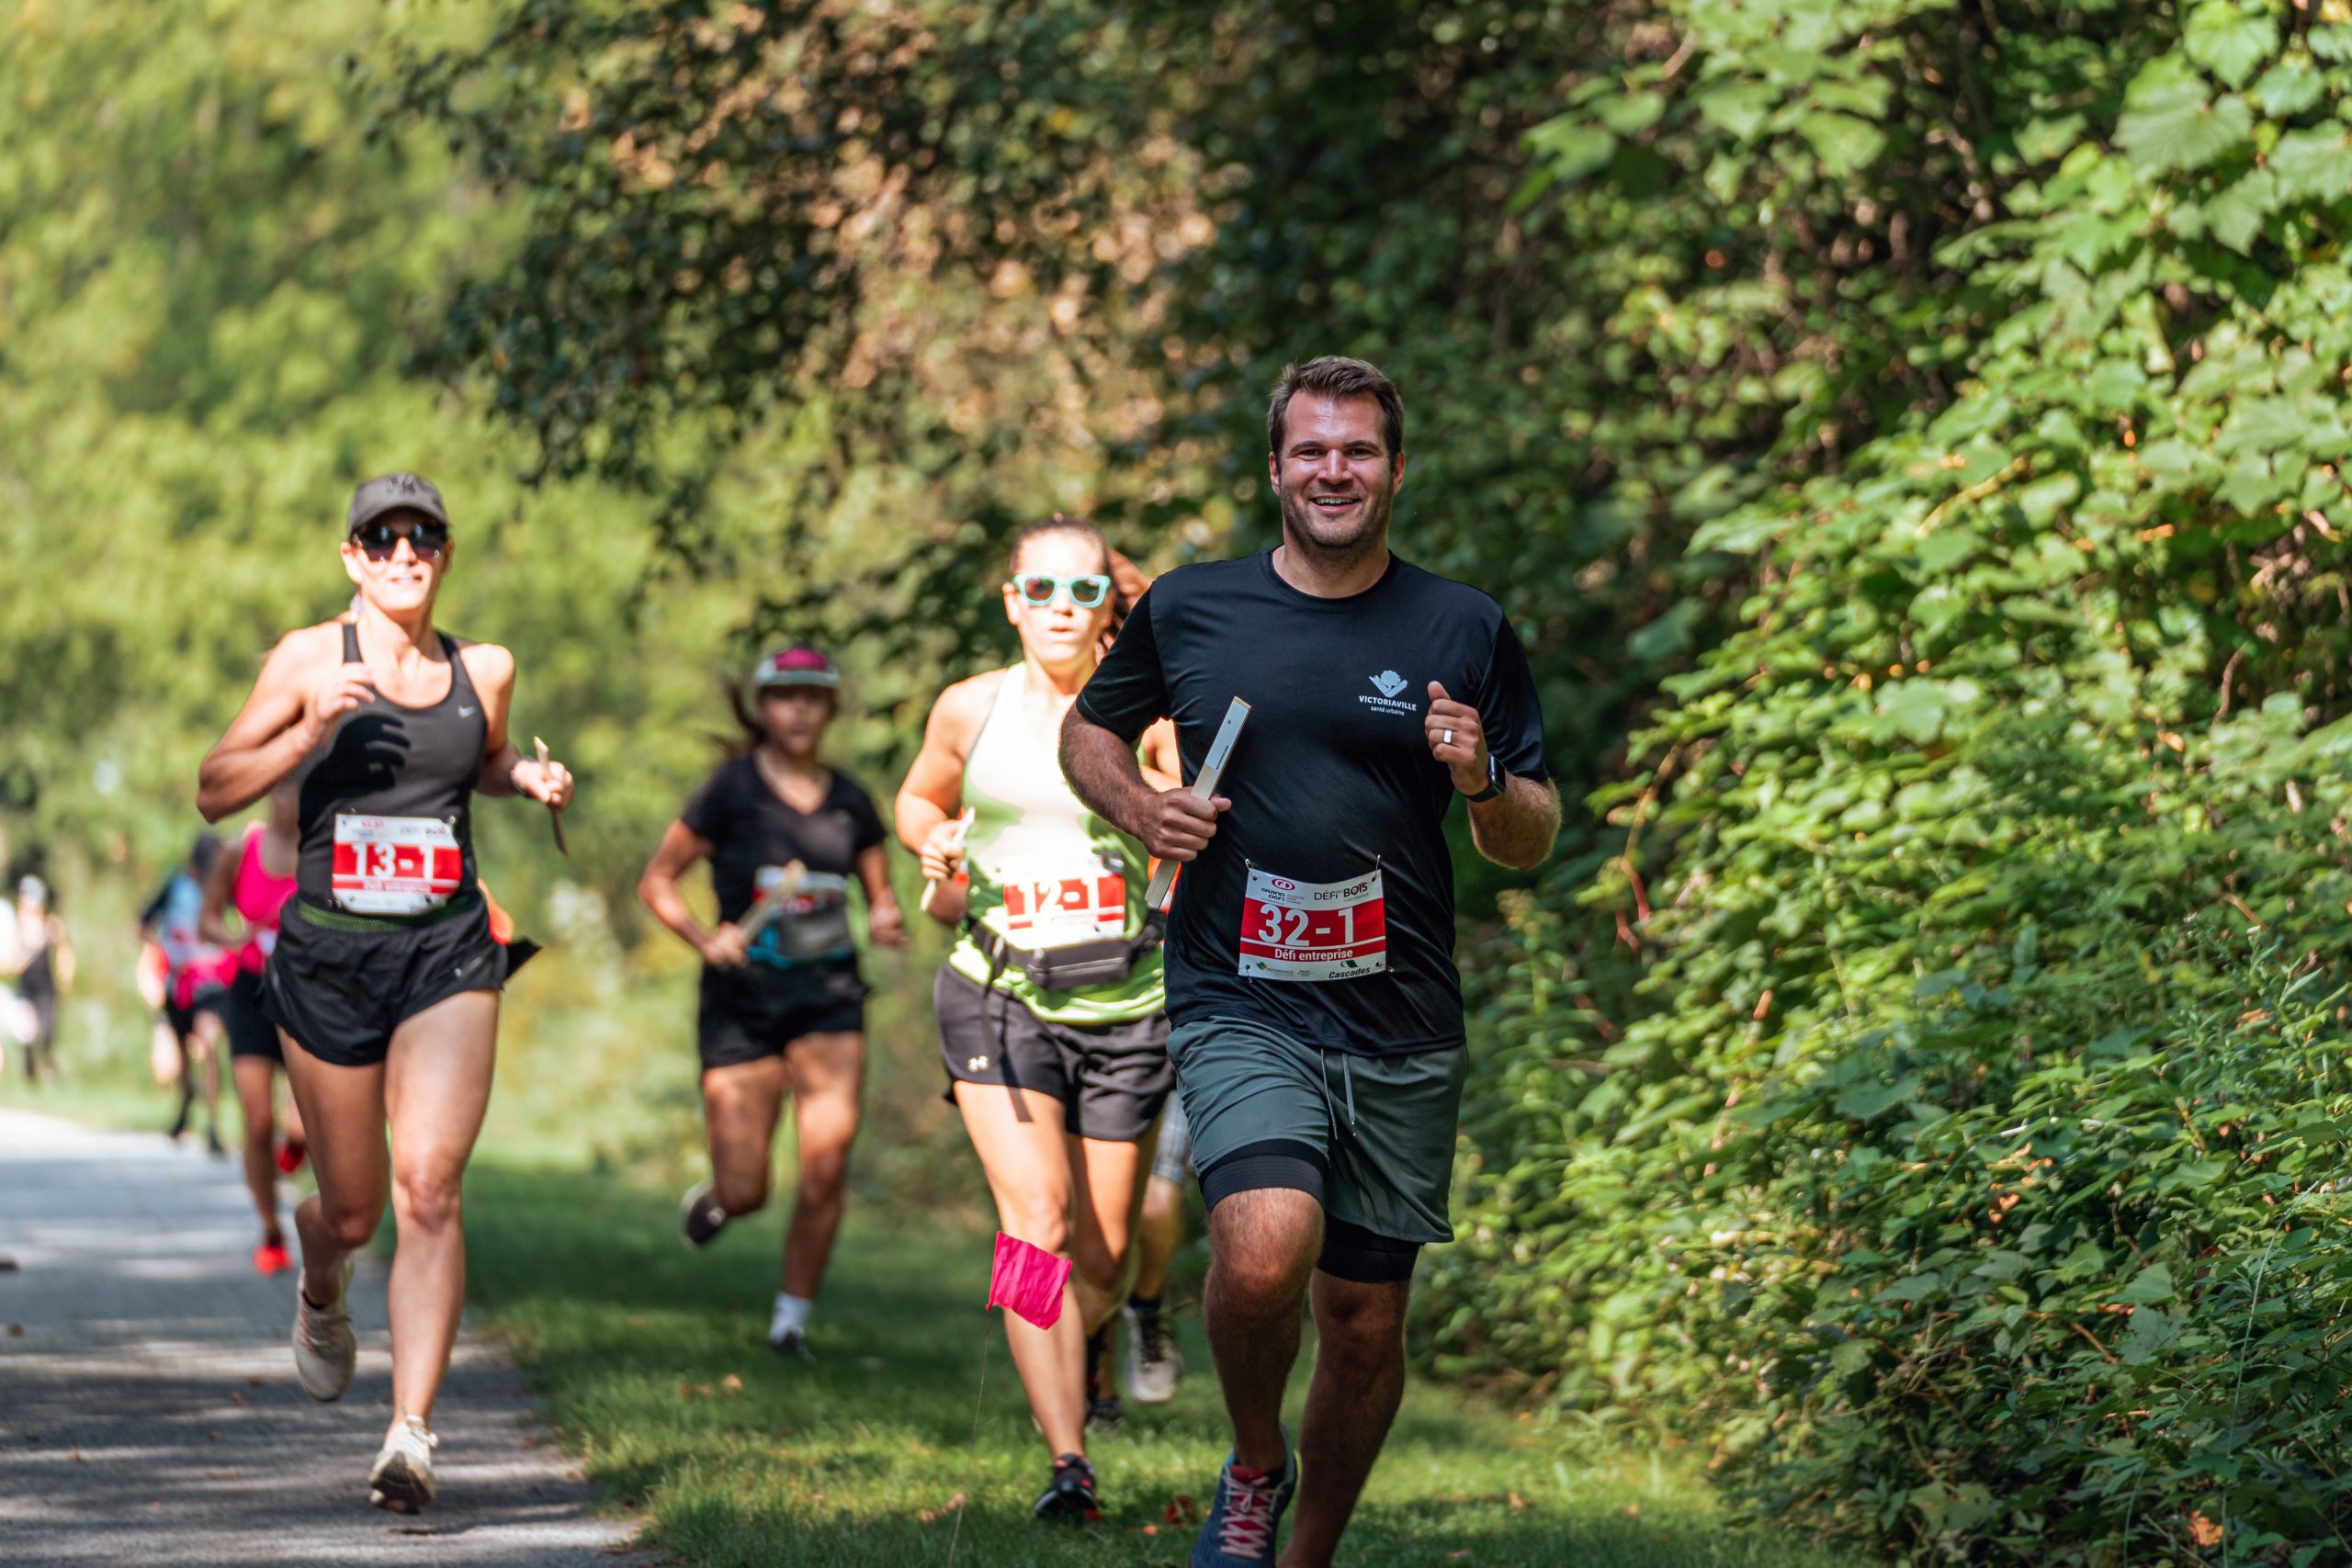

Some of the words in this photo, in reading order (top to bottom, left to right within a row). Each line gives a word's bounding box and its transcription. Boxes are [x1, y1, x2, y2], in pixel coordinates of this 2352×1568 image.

[1359, 695, 1417, 711] VICTORIAVILLE
[1385, 707, 1405, 716] urbaine
[350, 842, 434, 882] 13-1
[1017, 875, 1100, 916] 12-1
[1259, 903, 1354, 947] 32-1
[1274, 947, 1296, 960] Défi
[1299, 948, 1353, 962] entreprise
[1329, 966, 1371, 979] Cascades
